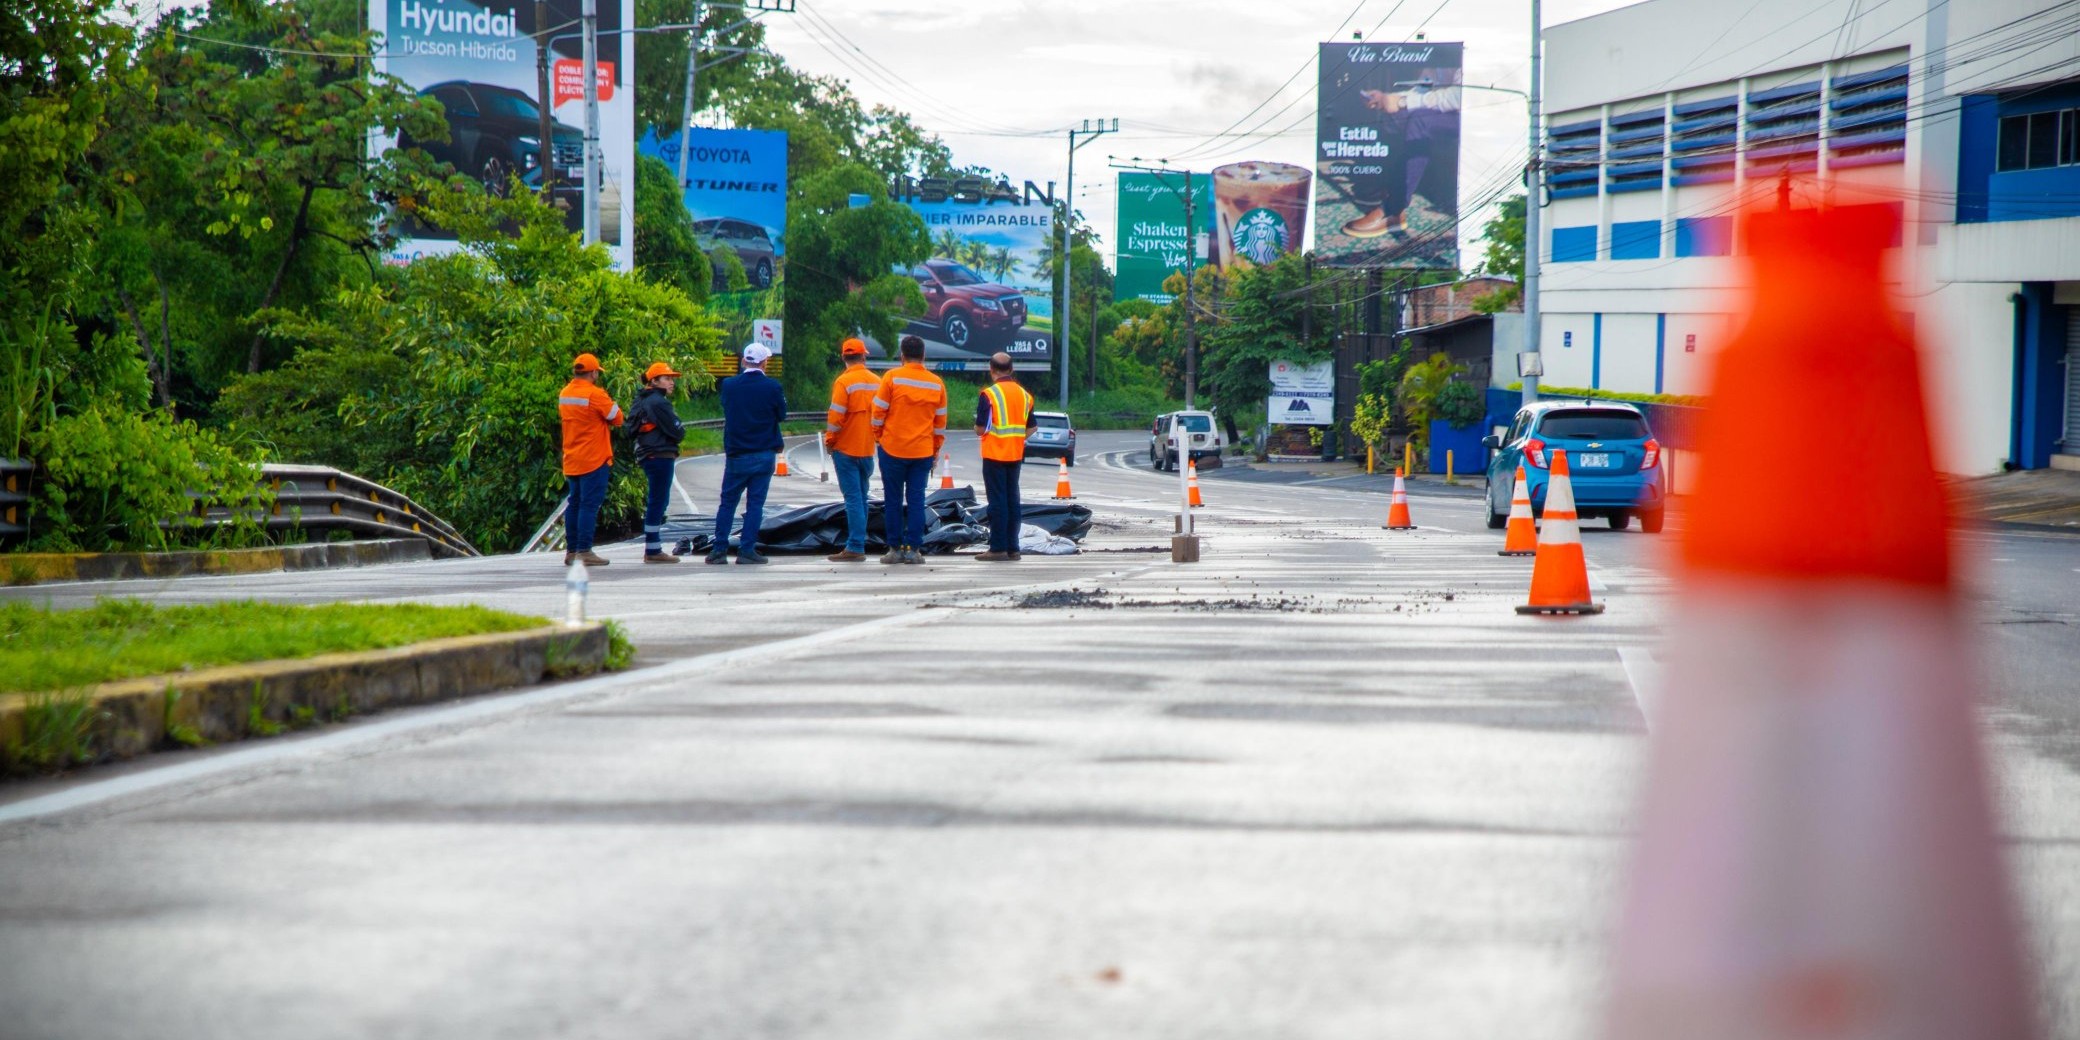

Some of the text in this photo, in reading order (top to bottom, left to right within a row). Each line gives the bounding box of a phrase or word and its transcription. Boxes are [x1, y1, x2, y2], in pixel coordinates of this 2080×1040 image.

[401, 1, 516, 37] Hyundai
[401, 35, 456, 56] Tucson
[1379, 45, 1434, 62] Brasil
[1340, 127, 1378, 140] Estilo
[688, 147, 751, 164] TOYOTA
[1337, 141, 1389, 157] Hereda
[1330, 166, 1382, 174] 100% CUERO
[1177, 184, 1205, 200] dy!
[957, 213, 1048, 226] IMPARABLE
[1133, 221, 1188, 236] Shaken
